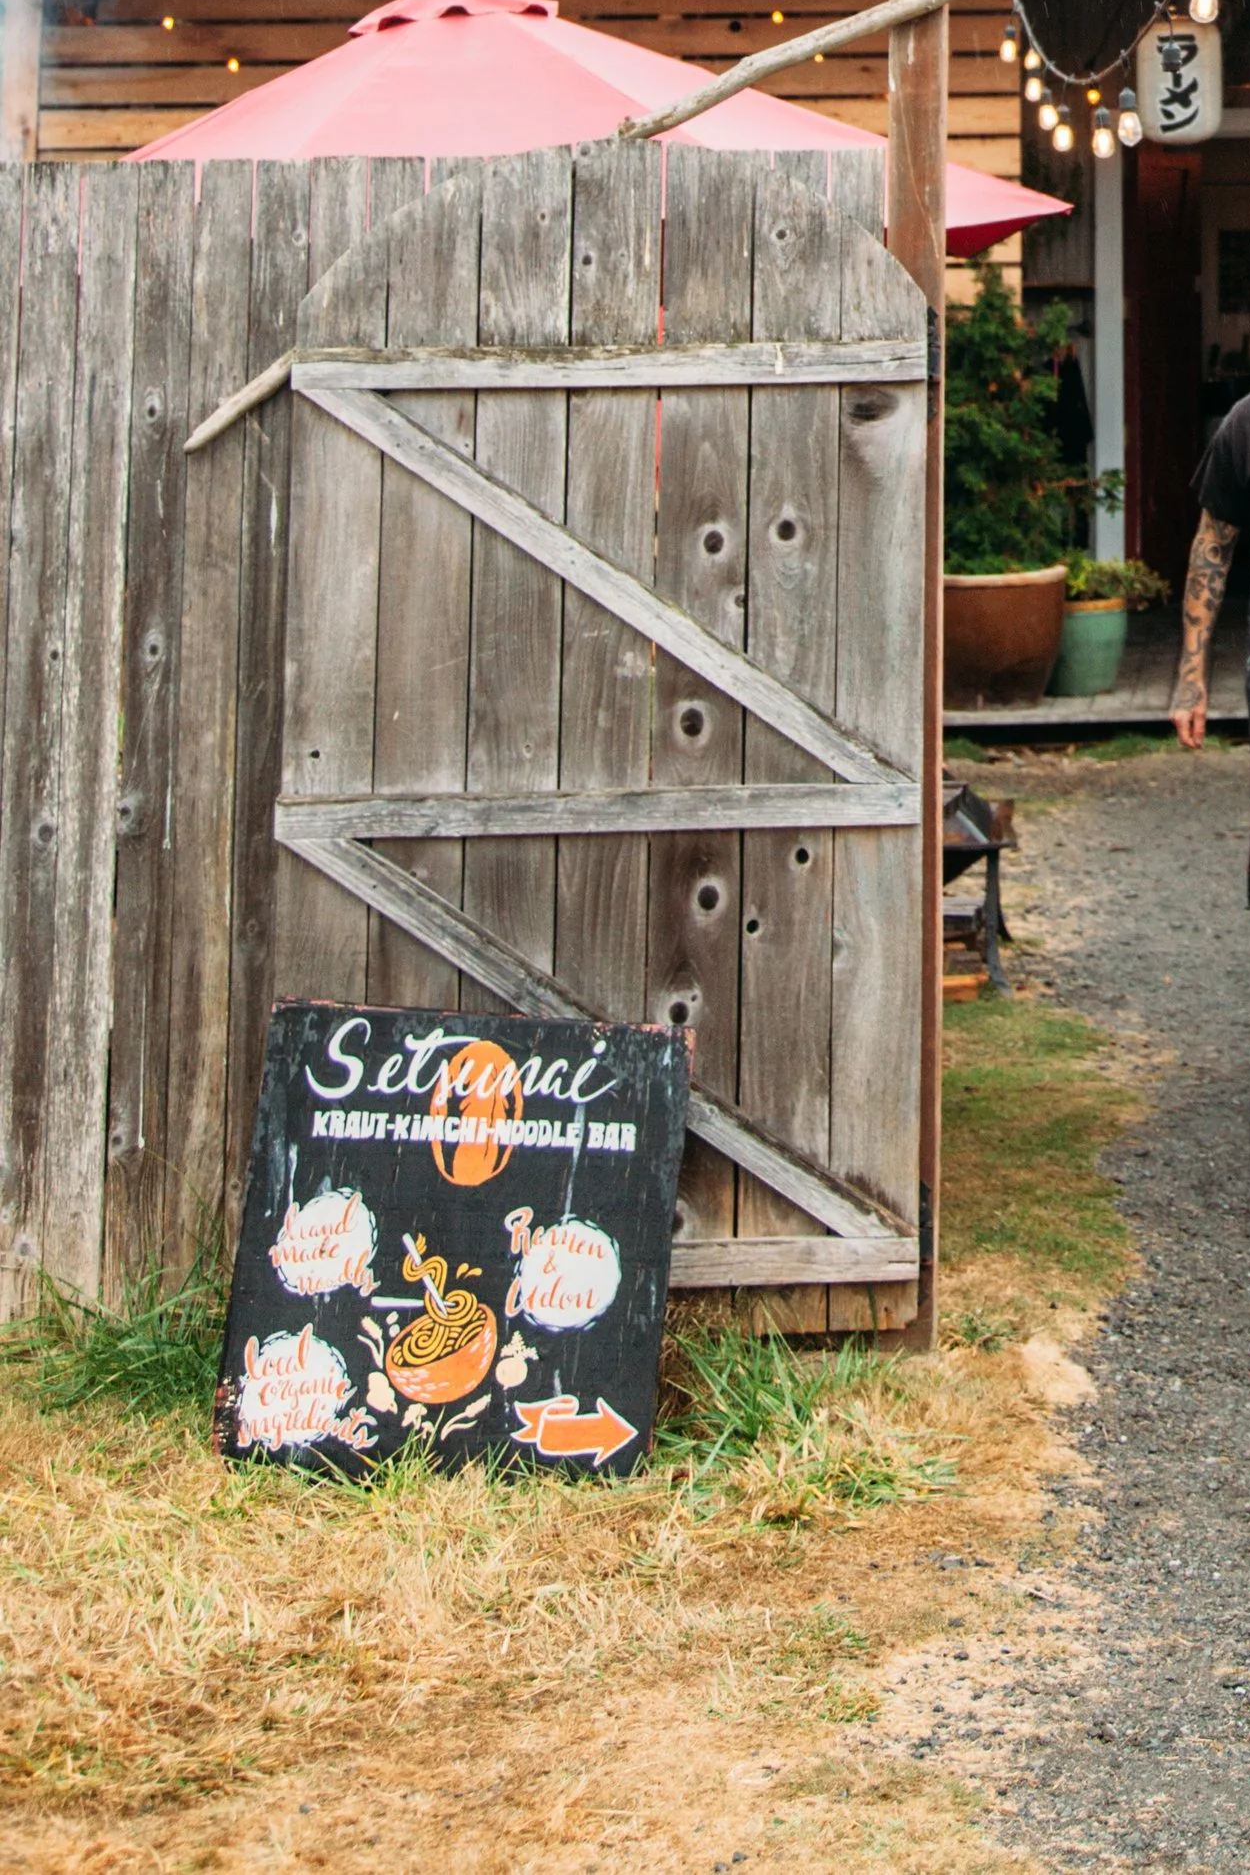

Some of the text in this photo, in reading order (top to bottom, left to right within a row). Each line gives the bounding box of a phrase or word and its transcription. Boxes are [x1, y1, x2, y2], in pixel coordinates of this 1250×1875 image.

[305, 1017, 618, 1106] Setsunai
[587, 1121, 636, 1151] BAR
[283, 1191, 362, 1242] hand
[504, 1206, 606, 1260] Ramen
[268, 1237, 341, 1267] made
[543, 1250, 558, 1274] &
[505, 1276, 600, 1318] Udon
[245, 1323, 313, 1381] local
[260, 1367, 357, 1411] organic
[237, 1399, 379, 1451] ingredients
